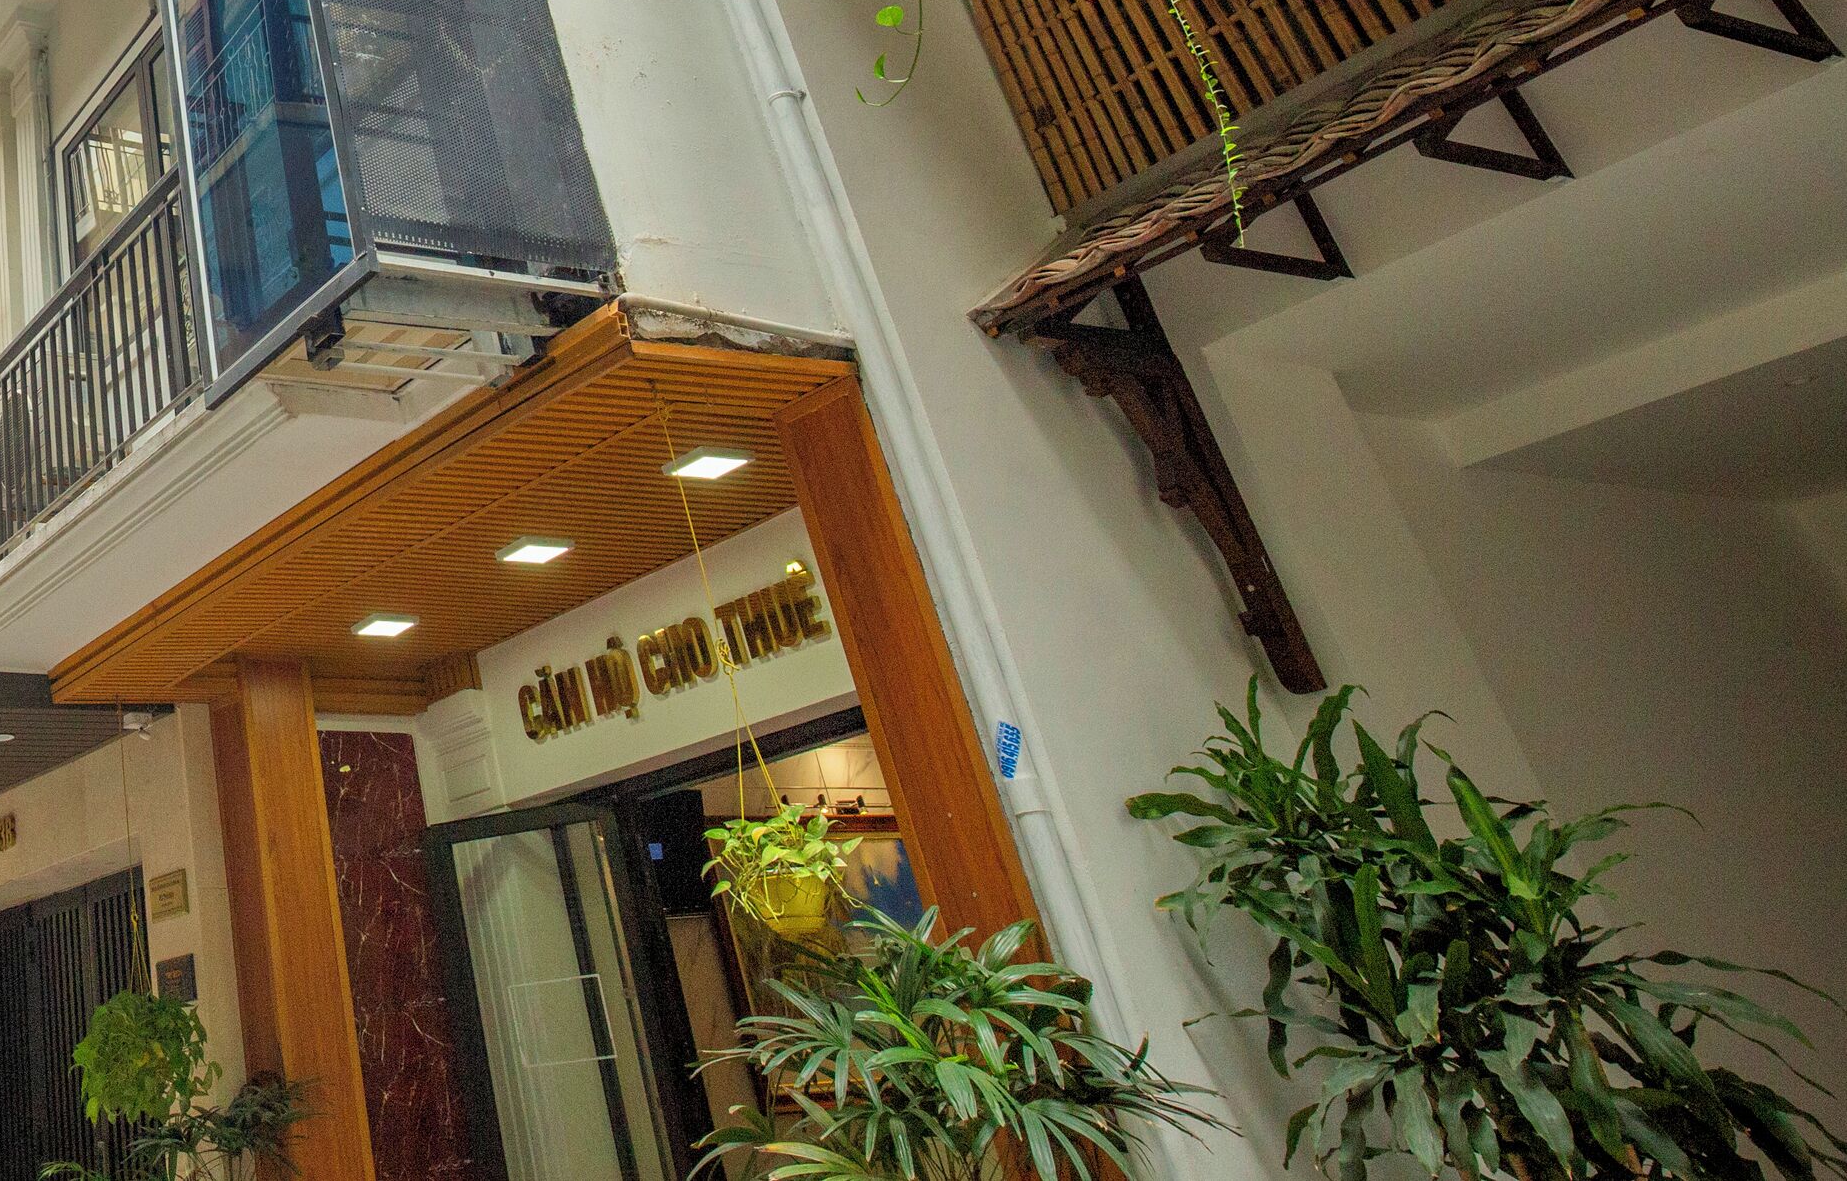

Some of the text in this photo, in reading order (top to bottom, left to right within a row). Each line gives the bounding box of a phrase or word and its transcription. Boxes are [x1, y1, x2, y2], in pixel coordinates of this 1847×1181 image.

[518, 560, 832, 742] CĂN HỘ CHO THUÊ
